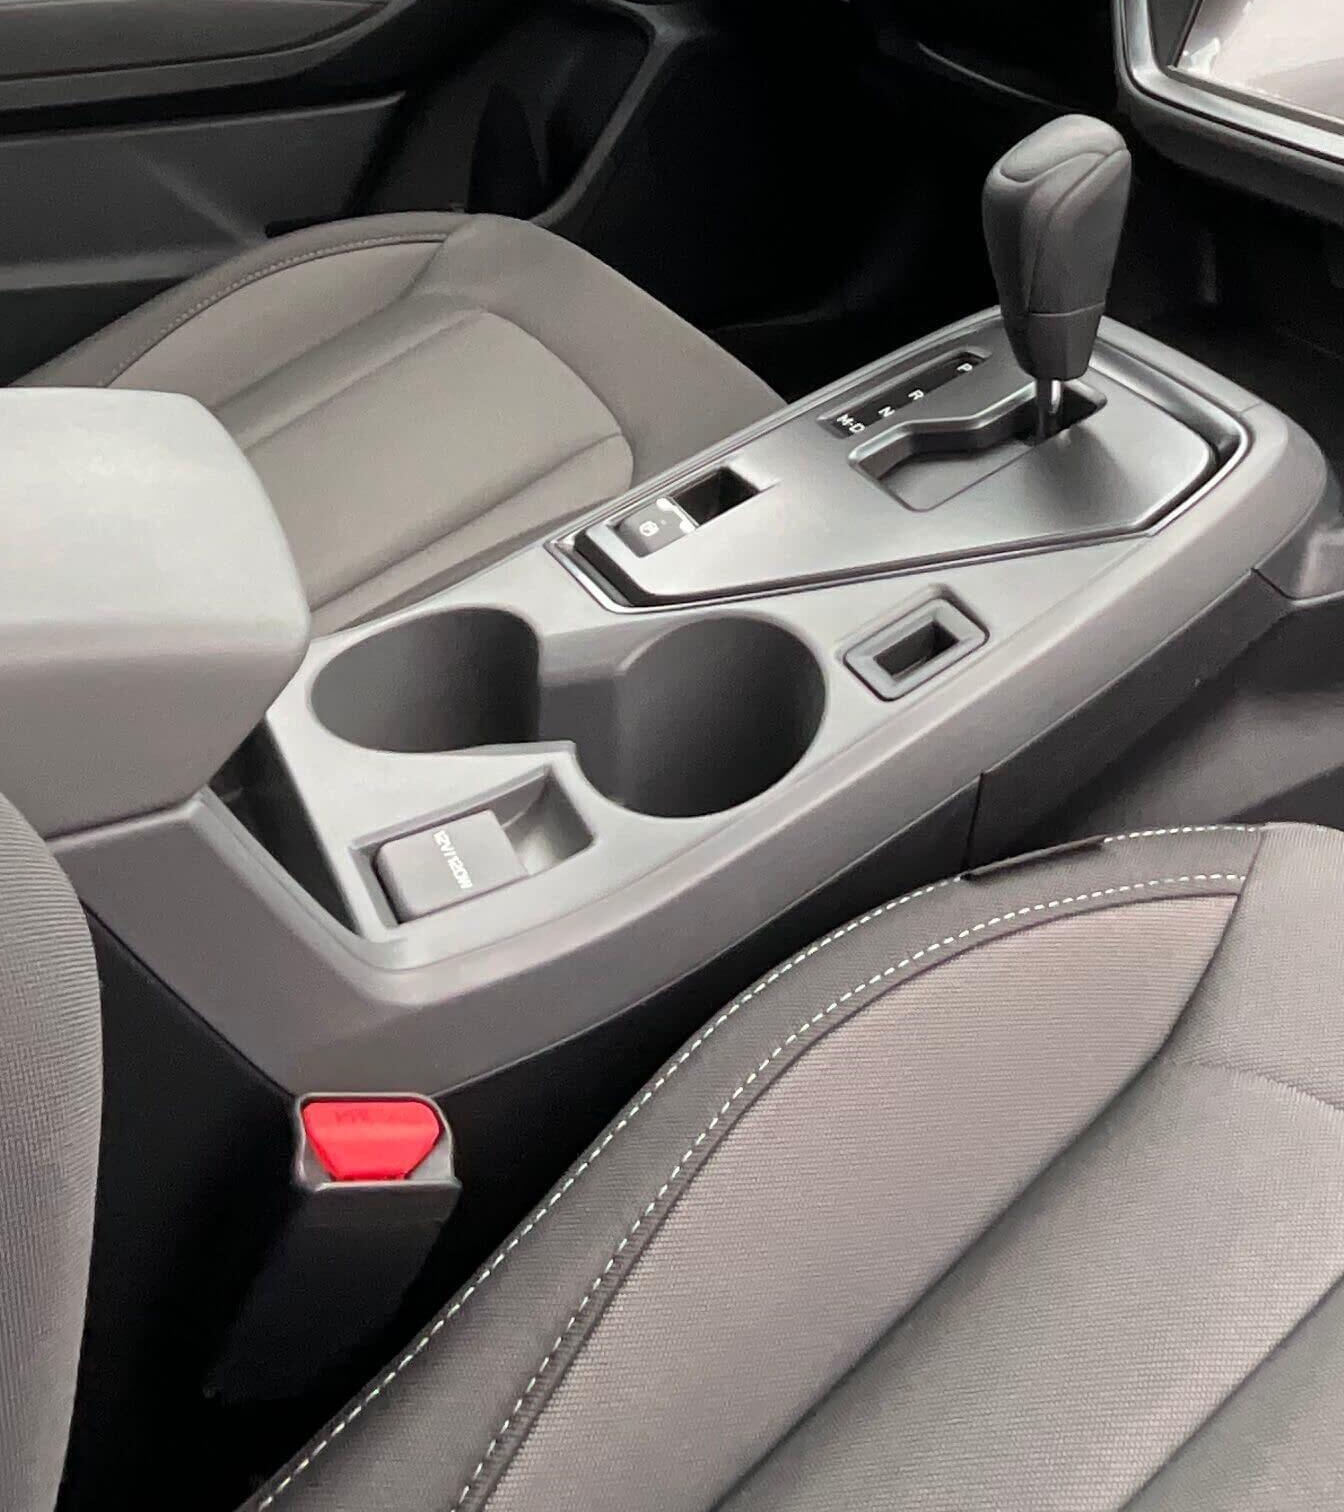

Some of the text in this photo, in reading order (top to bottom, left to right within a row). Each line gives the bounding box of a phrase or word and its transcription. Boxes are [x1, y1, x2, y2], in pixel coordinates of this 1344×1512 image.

[957, 363, 973, 372] P
[908, 389, 925, 400] R
[878, 406, 896, 418] N
